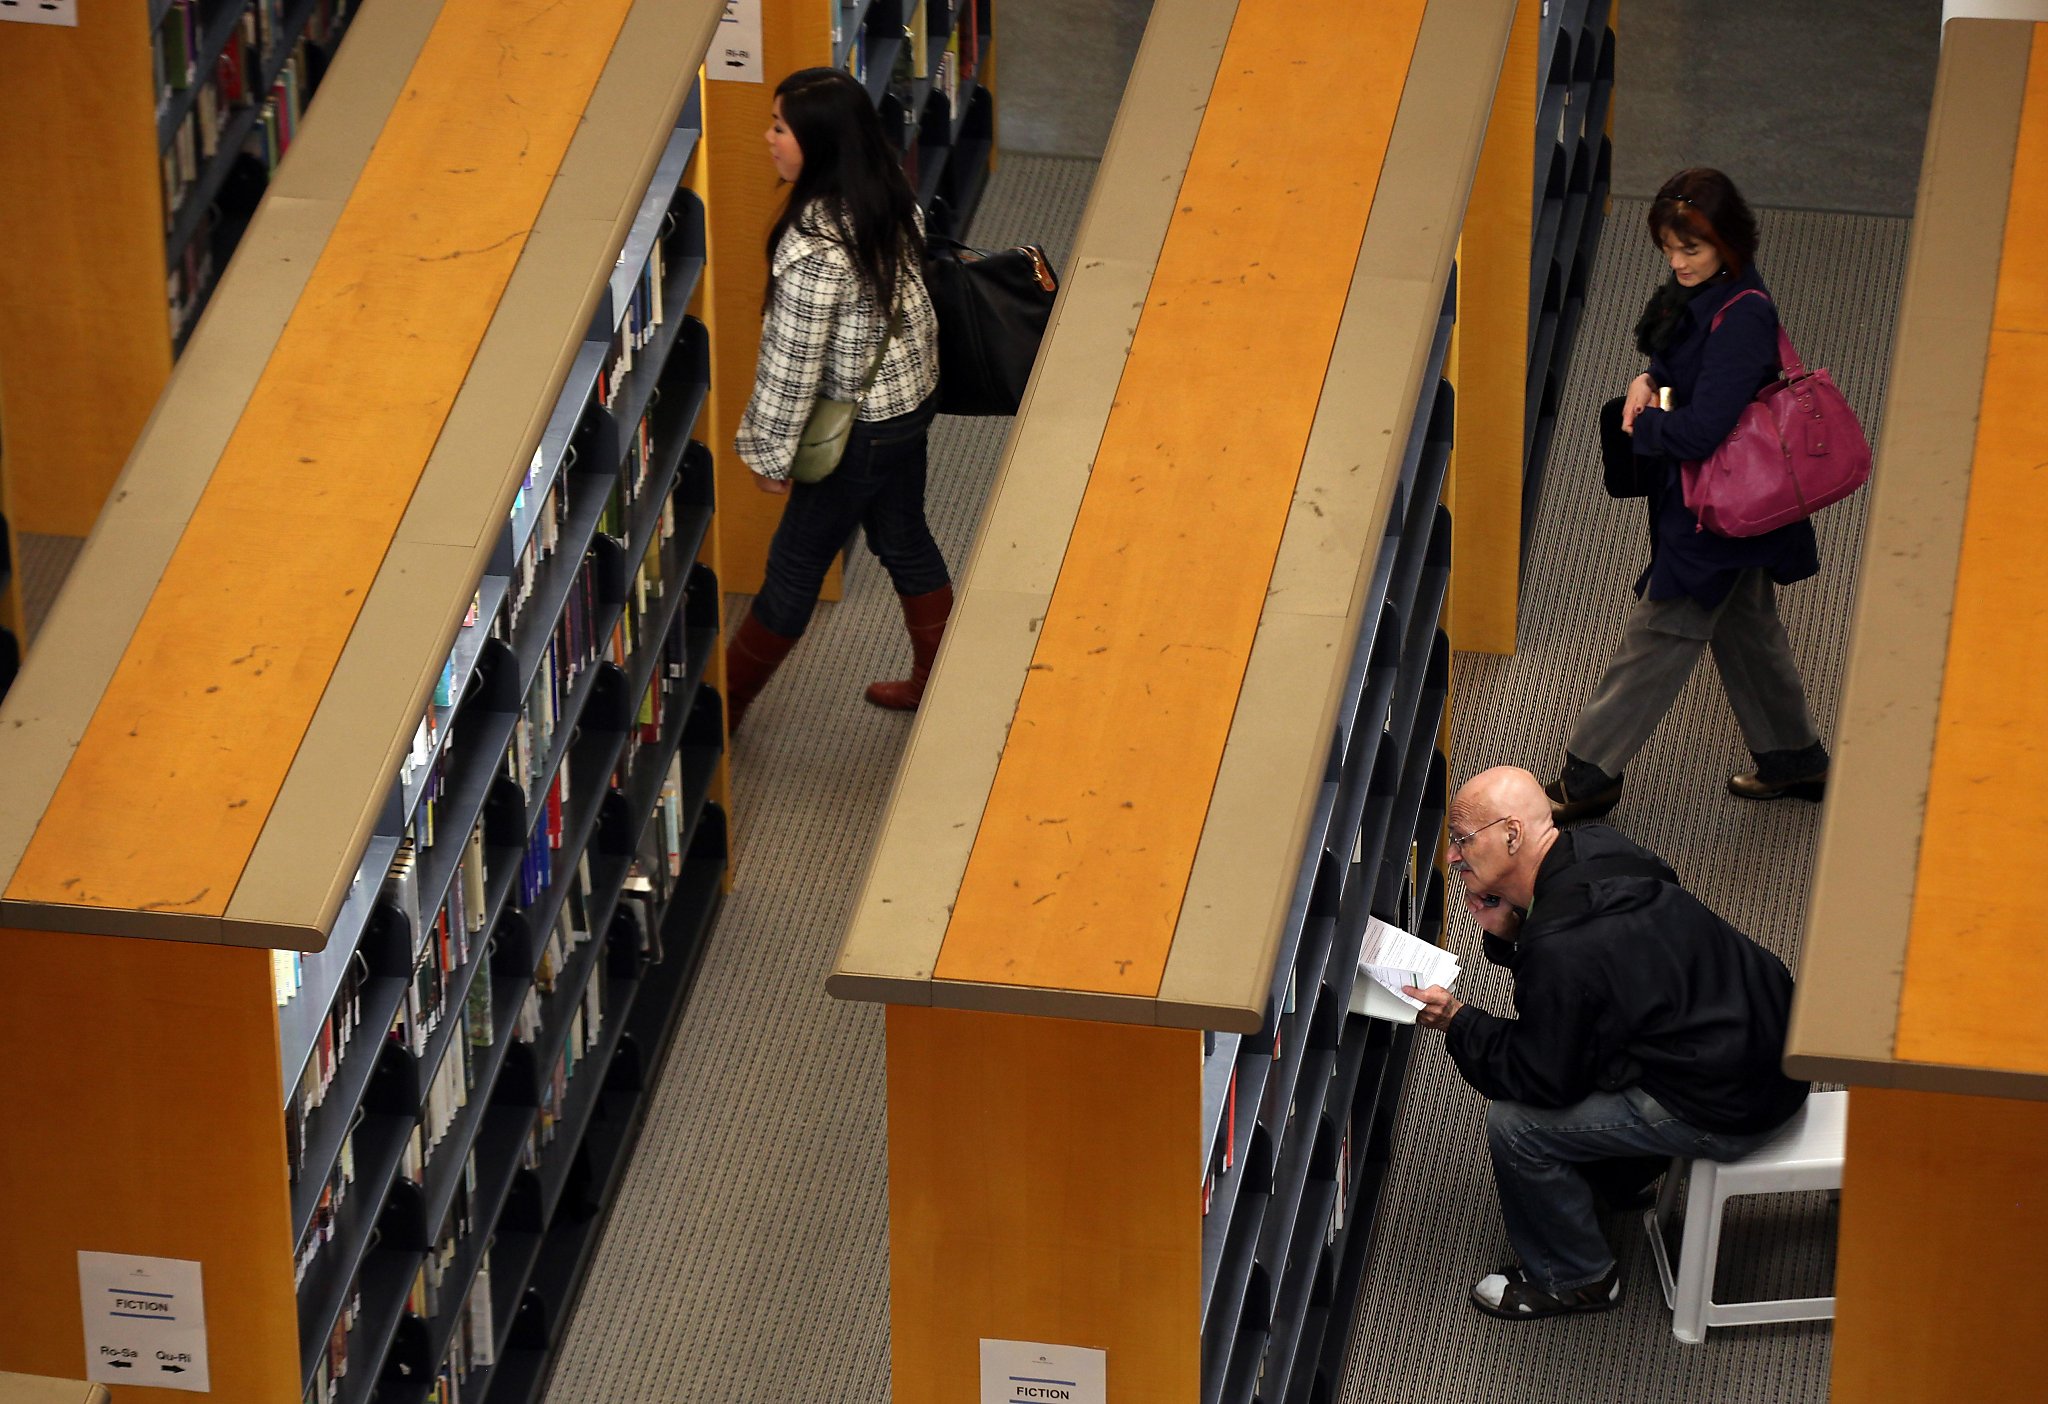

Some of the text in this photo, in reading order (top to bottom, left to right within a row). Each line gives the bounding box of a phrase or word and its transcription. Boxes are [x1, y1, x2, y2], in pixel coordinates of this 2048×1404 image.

[116, 1299, 168, 1312] FICTION
[100, 1346, 138, 1358] Ro-Sa
[155, 1351, 192, 1363] Qu-Ri
[1016, 1386, 1070, 1400] FICTION
